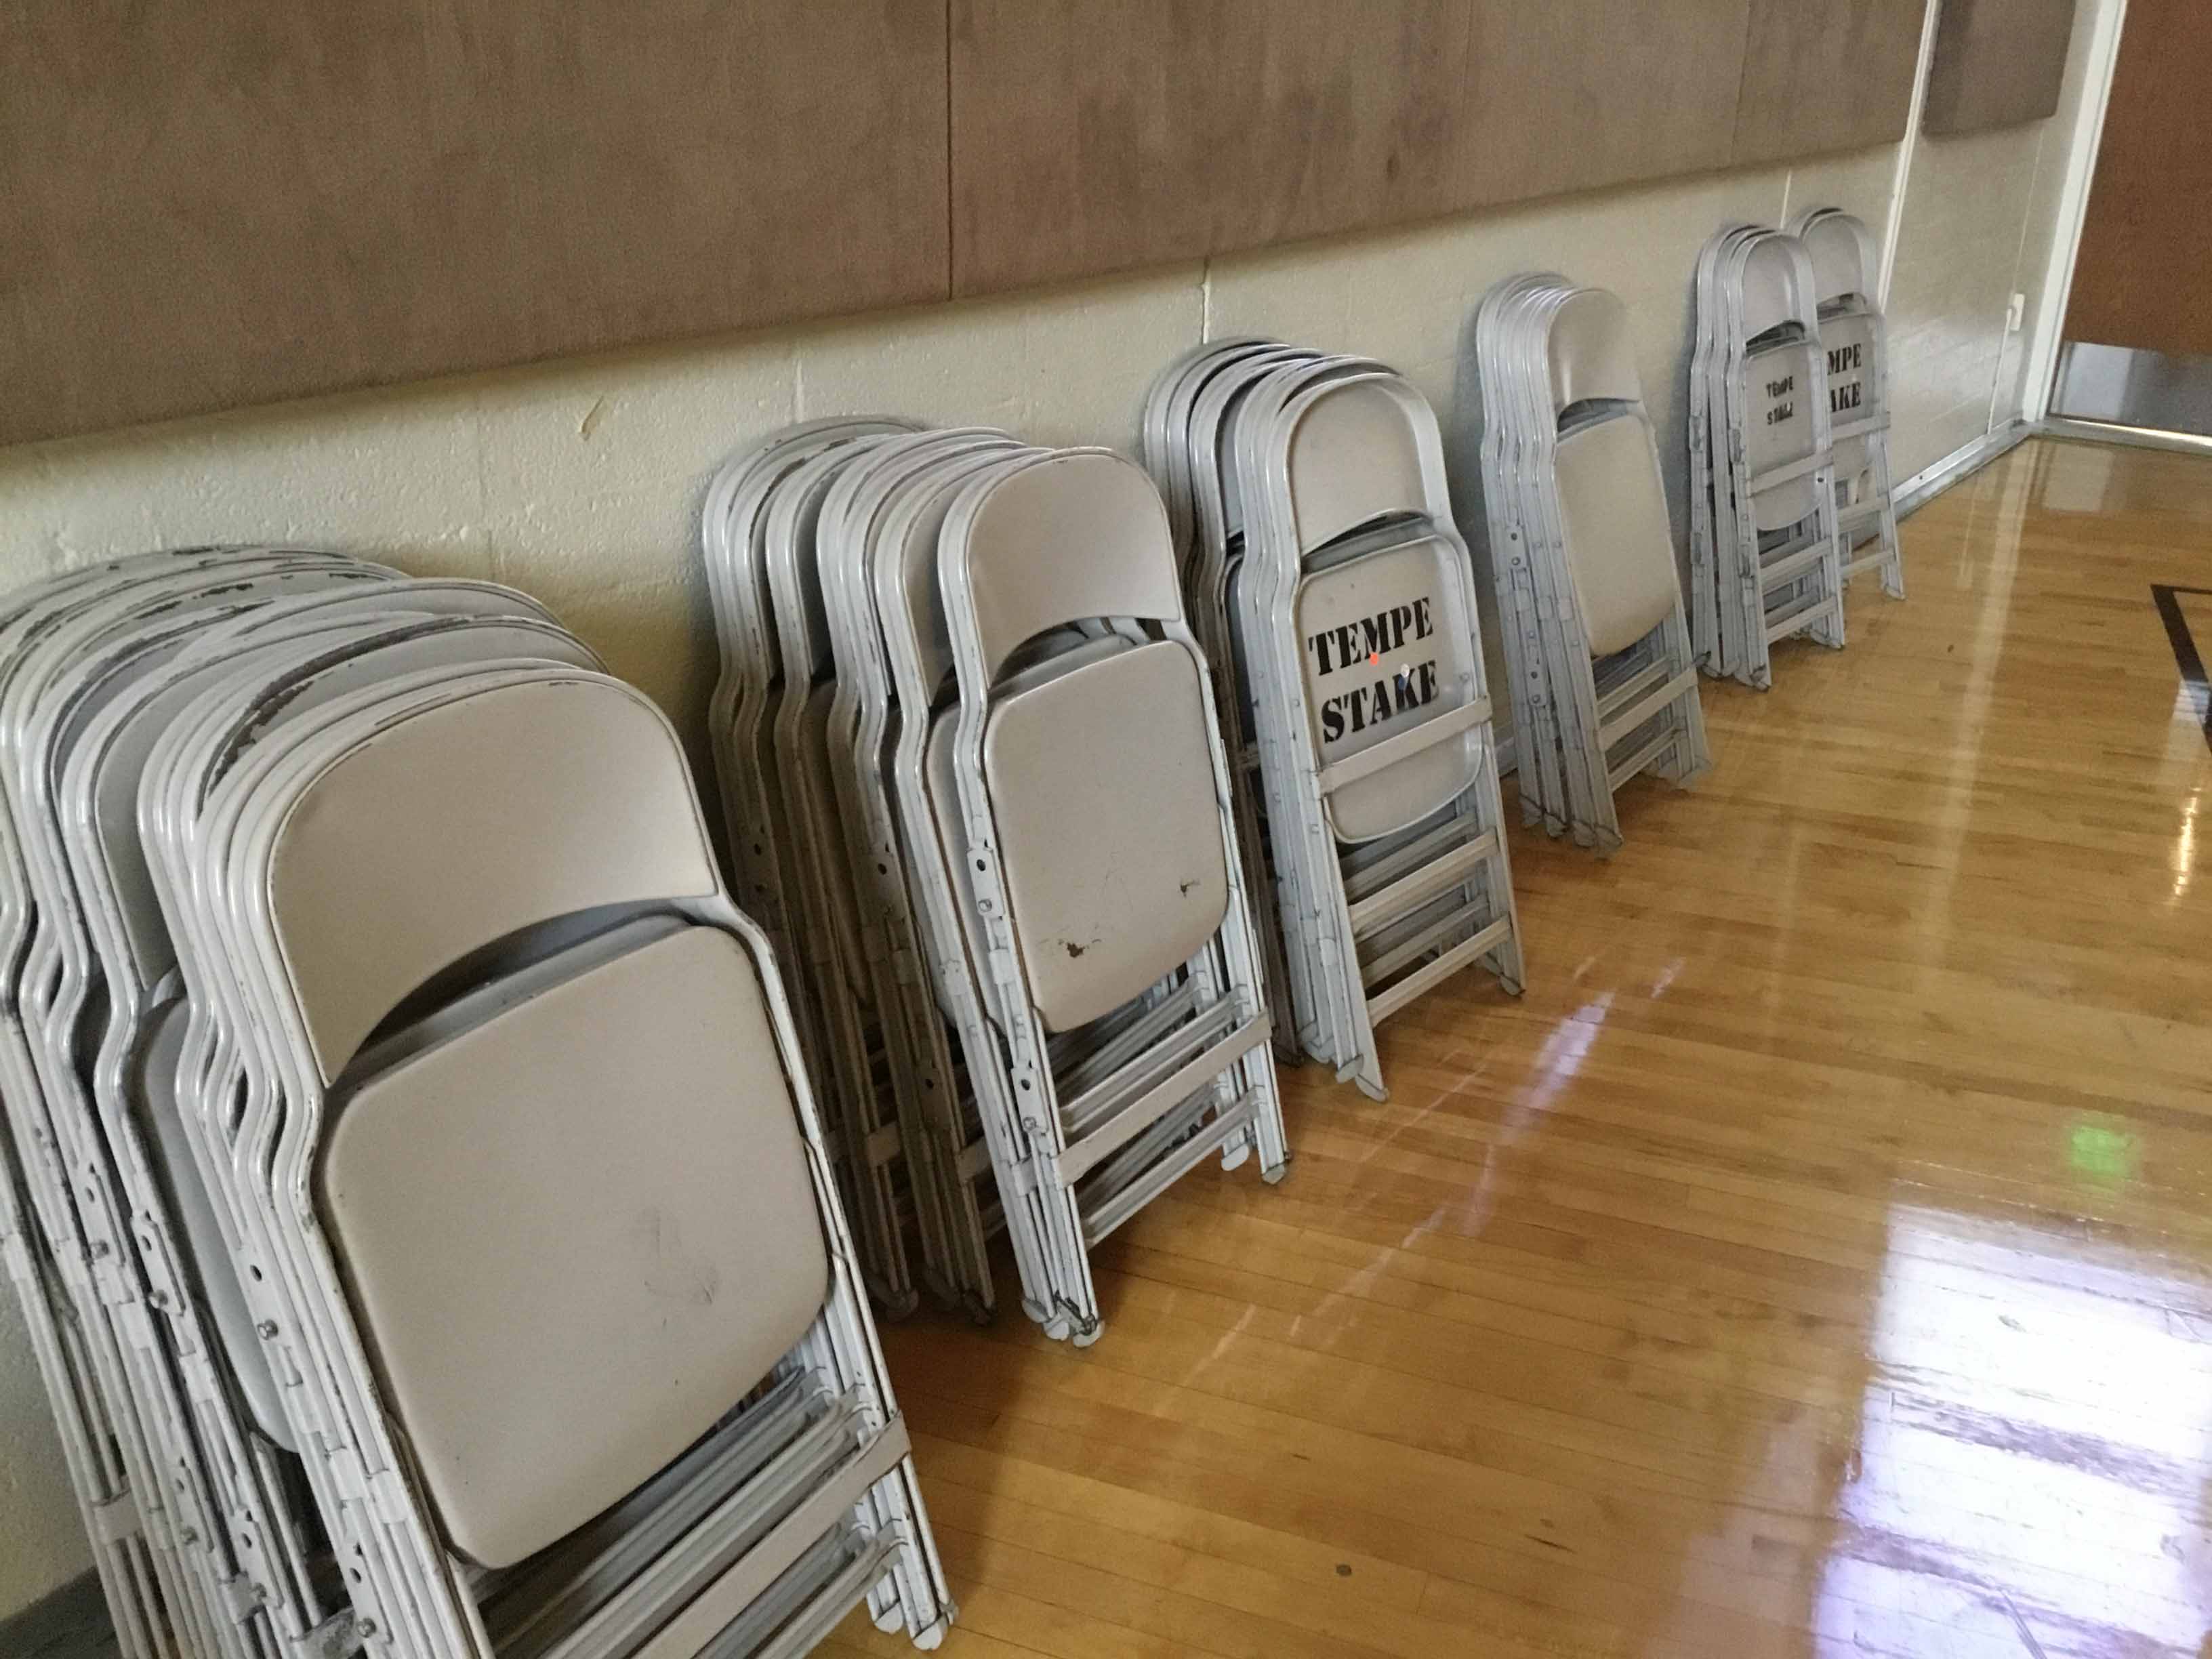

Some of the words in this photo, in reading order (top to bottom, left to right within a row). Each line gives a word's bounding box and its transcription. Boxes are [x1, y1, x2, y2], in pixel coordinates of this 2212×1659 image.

[1827, 343, 1862, 375] MPE
[1830, 382, 1862, 413] AKE
[1308, 596, 1433, 676] TEMPE
[1322, 659, 1439, 743] STAKE
